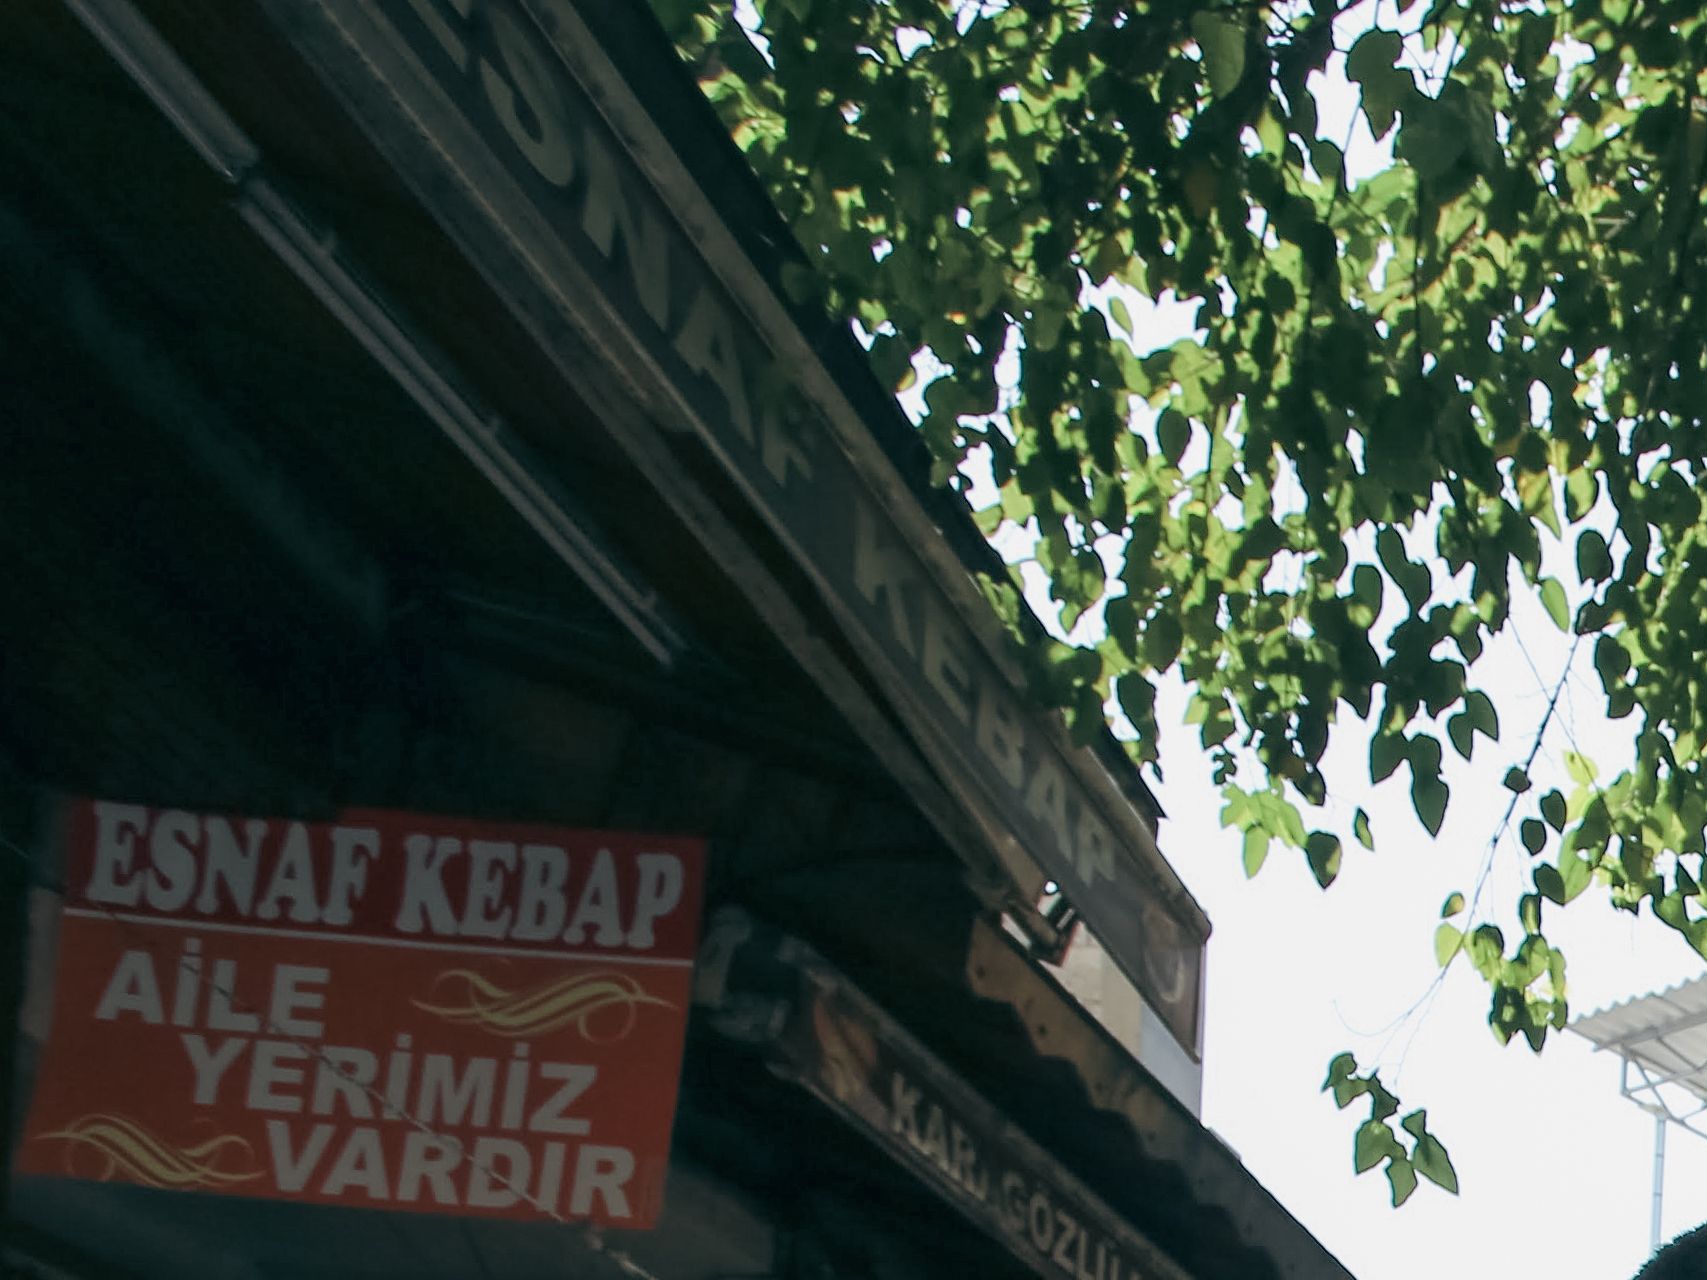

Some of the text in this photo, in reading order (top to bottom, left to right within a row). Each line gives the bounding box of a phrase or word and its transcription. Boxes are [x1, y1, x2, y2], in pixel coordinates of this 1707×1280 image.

[86, 802, 684, 950] ESNAF KEBAP
[94, 937, 332, 1039] AİLE
[180, 1032, 599, 1137] YERİMİZ
[891, 1072, 987, 1200] KAR
[266, 1120, 637, 1219] VARDIR
